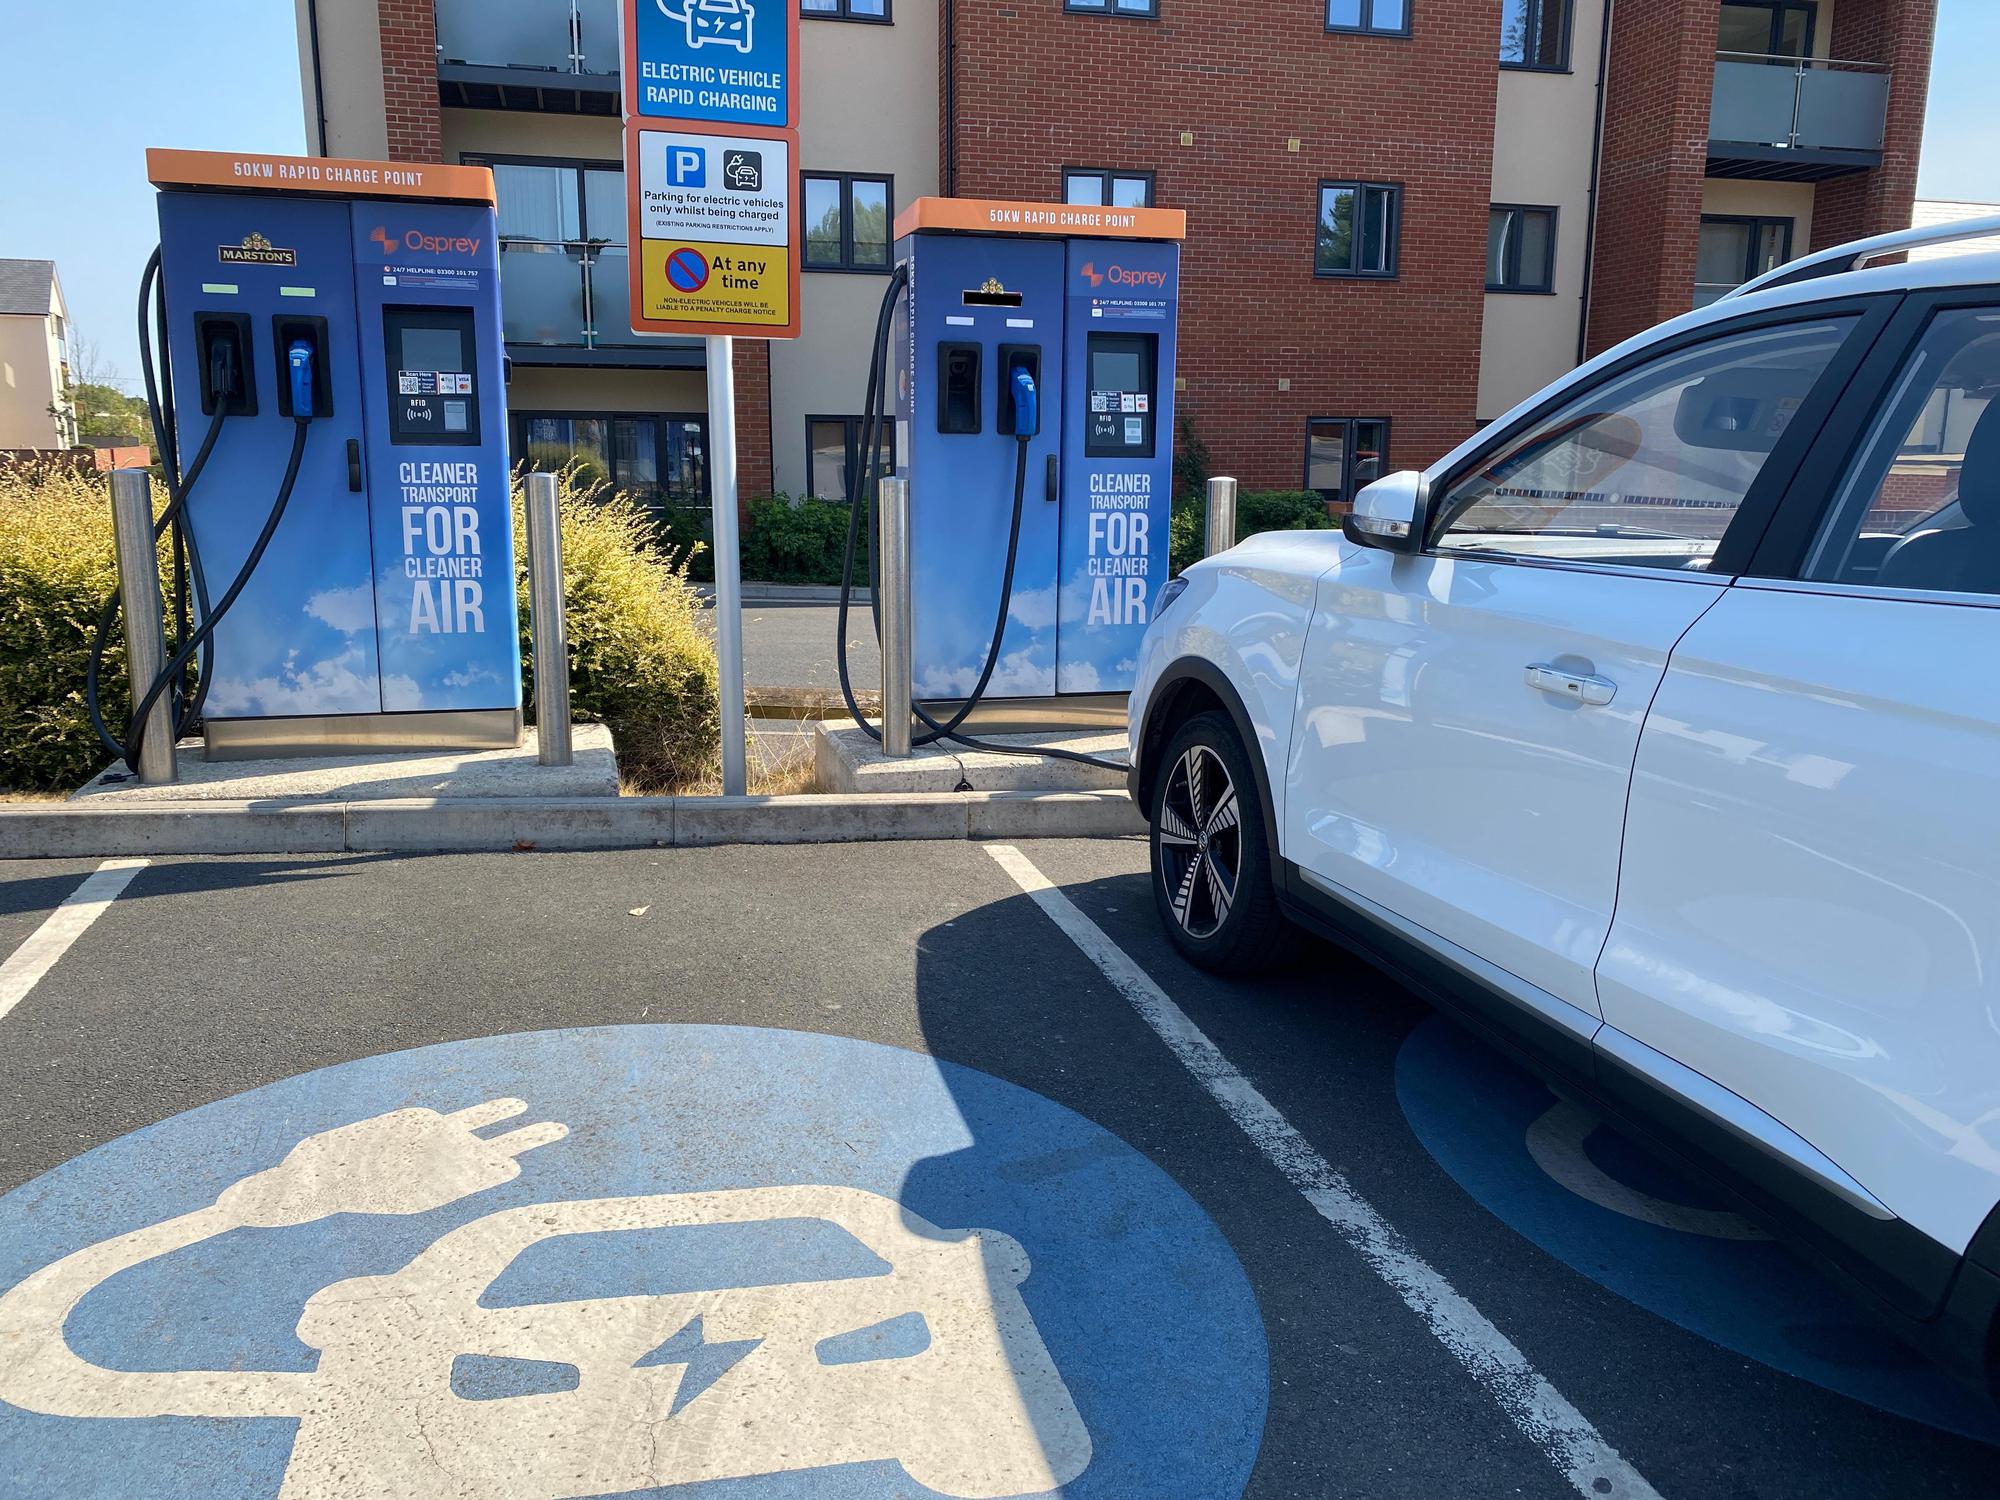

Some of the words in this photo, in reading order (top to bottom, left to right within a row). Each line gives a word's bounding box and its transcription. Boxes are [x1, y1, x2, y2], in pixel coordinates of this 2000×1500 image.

[642, 61, 715, 83] ELECTRIC
[719, 68, 781, 89] VEHICLE
[647, 86, 694, 105] RAPID
[698, 90, 777, 113] CHARGING
[233, 162, 273, 177] 50KW
[279, 164, 321, 180] RAPID
[325, 167, 379, 184] CHARGE
[384, 170, 423, 186] POINT
[676, 151, 700, 183] P
[644, 190, 684, 204] Parking
[686, 193, 701, 203] for
[703, 195, 741, 206] electric
[743, 198, 784, 209] vehicles
[650, 204, 673, 215] only
[675, 206, 705, 216] whilst
[708, 208, 736, 219] being
[738, 210, 779, 222] charged
[990, 209, 1020, 223] 50KW
[1024, 211, 1056, 225] RAPID
[1060, 212, 1101, 226] CHARGE
[1105, 214, 1136, 227] POINT
[655, 220, 685, 228] (EXISTING
[711, 223, 753, 232] RESTRICTIONS
[405, 230, 480, 256] Osprey
[222, 250, 293, 262] MARSTON'S
[712, 256, 732, 271] At
[737, 260, 766, 275] any
[721, 274, 759, 290] time
[1108, 265, 1167, 288] Osprey
[663, 297, 710, 306] NON-ELECTRIC
[711, 299, 743, 307] VEHICLES
[725, 307, 752, 315] CHARGE
[753, 308, 776, 316] NOTICE
[410, 399, 426, 407] RFID
[400, 462, 478, 485] CLEANER
[1090, 473, 1151, 493] CLEANER
[401, 486, 478, 503] TRANSPORT
[1090, 495, 1150, 510] TRANSPORT
[402, 505, 481, 555] FOR
[1088, 511, 1149, 556] FOR
[405, 557, 483, 578] CLEANER
[1088, 557, 1148, 577] CLEANER
[409, 579, 485, 634] AIR
[1087, 577, 1147, 625] AIR
